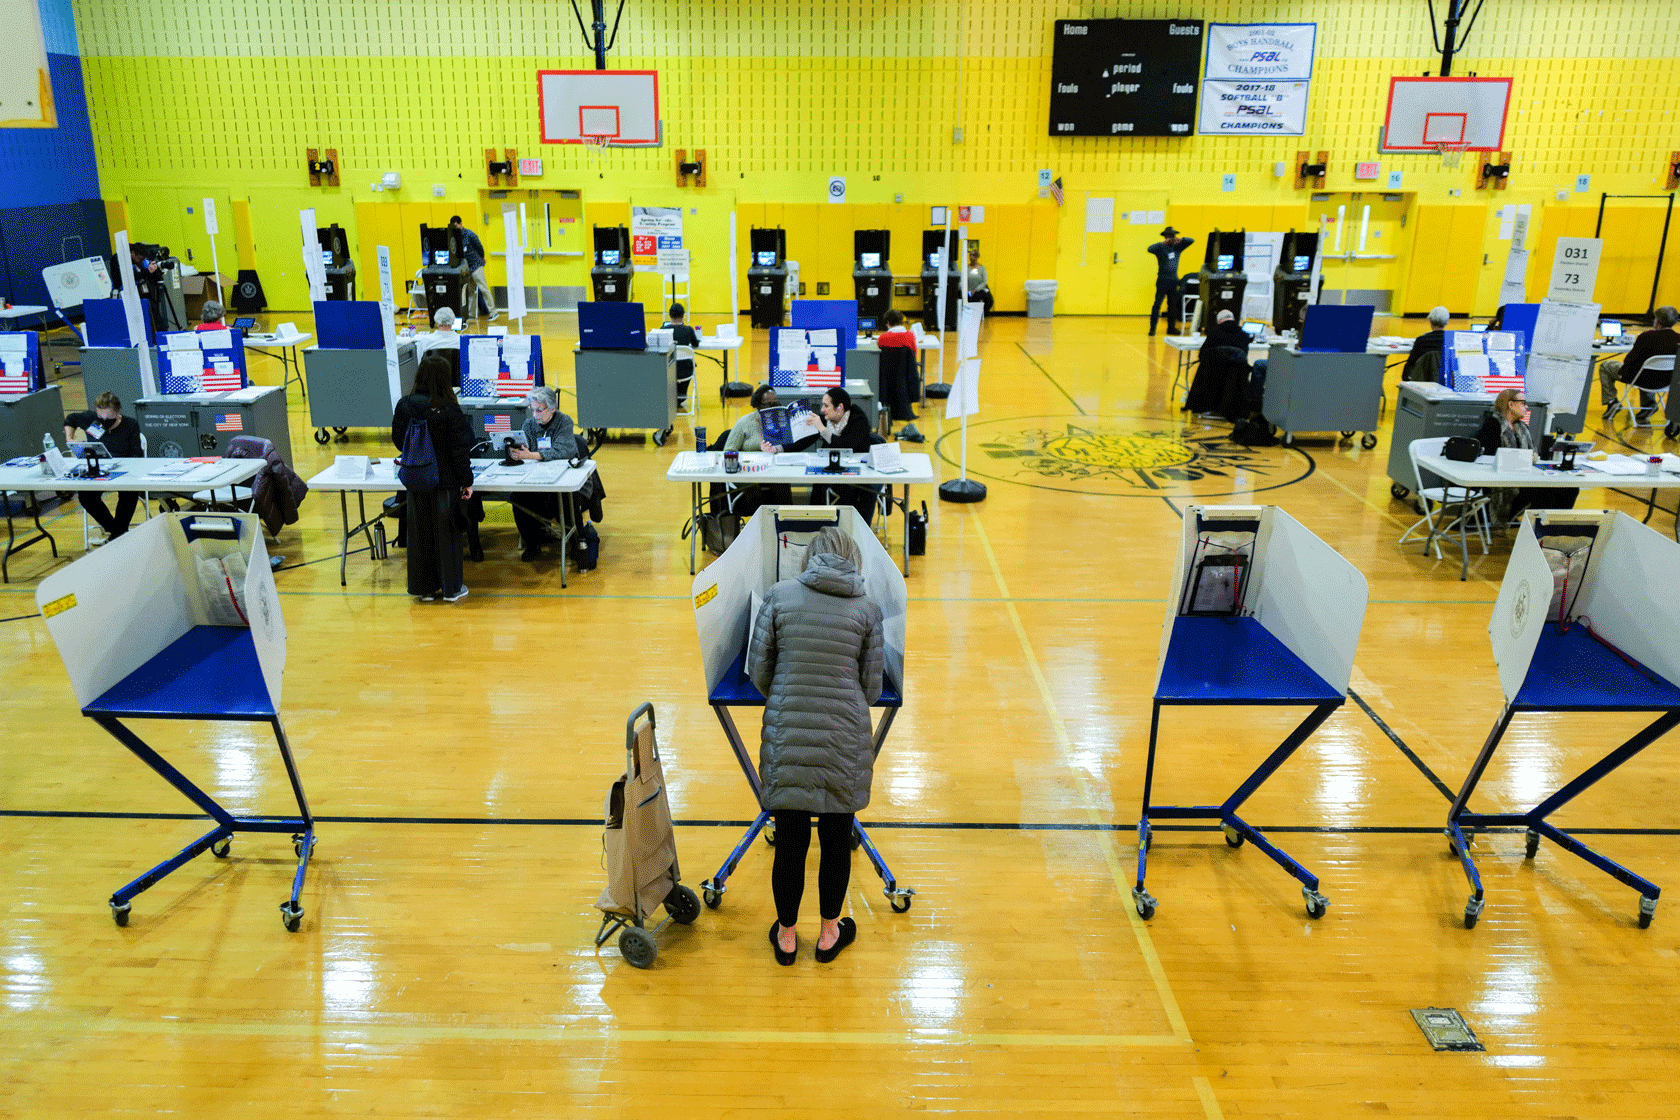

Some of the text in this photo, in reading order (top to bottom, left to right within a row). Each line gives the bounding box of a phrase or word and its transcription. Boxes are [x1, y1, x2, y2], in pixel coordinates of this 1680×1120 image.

[1063, 24, 1089, 35] Home
[1169, 24, 1200, 35] Guests
[1226, 38, 1294, 52] BOYS HANDBALL
[1113, 63, 1142, 75] period
[1227, 63, 1289, 75] CHAMPIONS
[1058, 83, 1079, 93] fouls
[1111, 82, 1140, 94] player
[1173, 83, 1194, 93] fouls
[1220, 93, 1267, 101] SOFTBALL
[1058, 123, 1075, 131] won
[1111, 123, 1134, 133] game
[1171, 123, 1189, 131] won
[522, 159, 539, 173] EXIT
[1040, 172, 1050, 180] 12
[1224, 177, 1233, 185] 14
[1565, 247, 1588, 259] 031
[1565, 273, 1580, 284] 73
